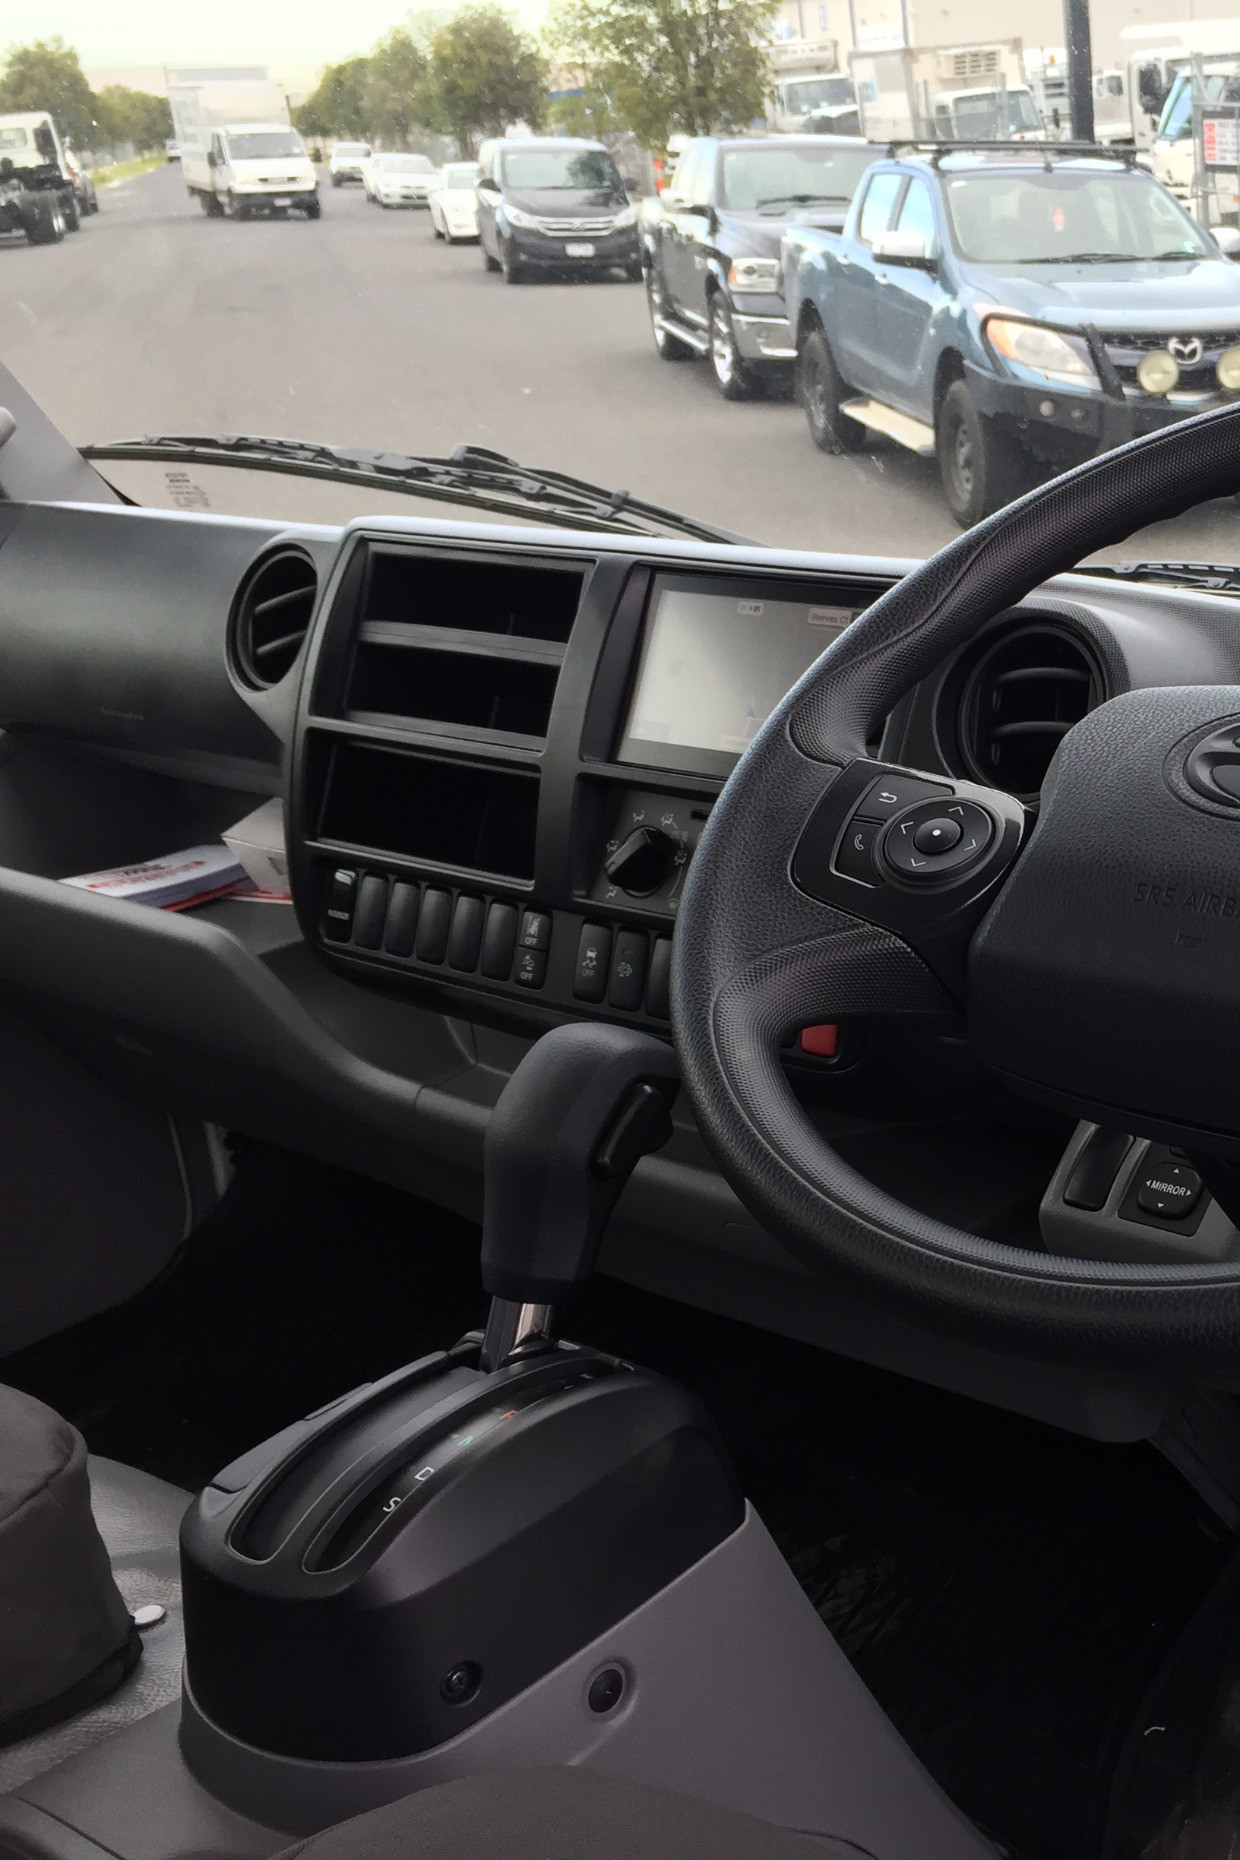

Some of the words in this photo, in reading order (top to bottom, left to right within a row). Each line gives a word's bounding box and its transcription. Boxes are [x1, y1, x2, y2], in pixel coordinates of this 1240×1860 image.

[1132, 882, 1176, 907] SRS
[524, 936, 538, 945] OFF
[520, 971, 533, 980] OFF
[1150, 1180, 1186, 1196] MIRROR
[414, 1466, 434, 1481] D
[382, 1496, 402, 1513] S
